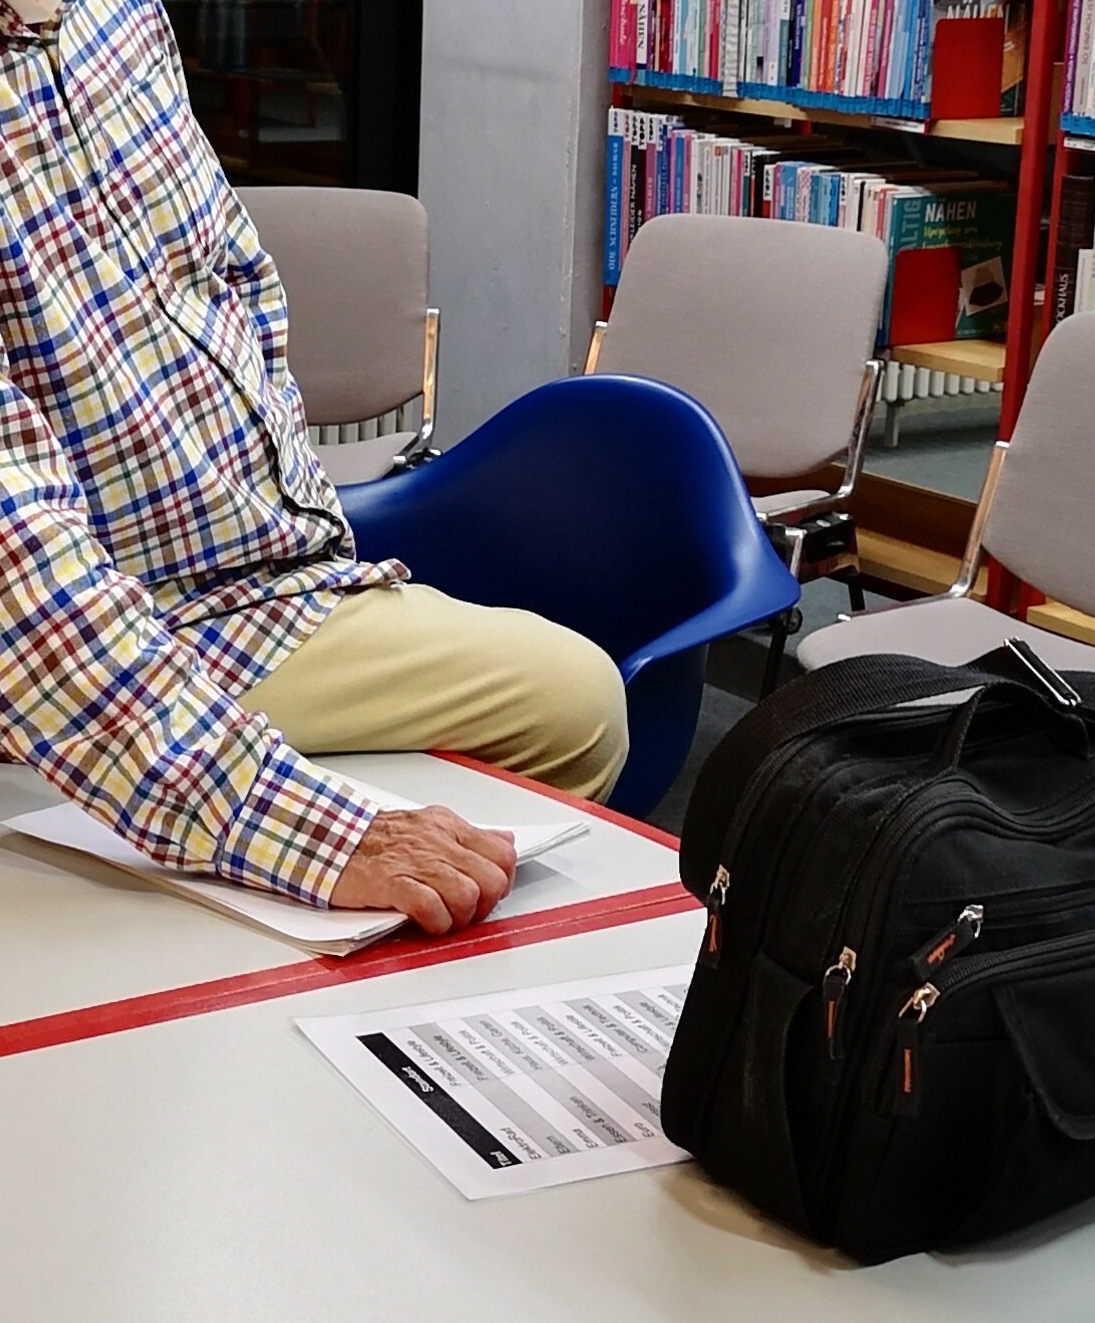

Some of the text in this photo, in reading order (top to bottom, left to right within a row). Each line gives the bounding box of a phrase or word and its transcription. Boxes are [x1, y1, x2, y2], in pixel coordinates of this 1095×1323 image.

[637, 4, 647, 49] NÄHEN
[925, 199, 977, 223] NÄHEN
[901, 199, 921, 249] ALTIG
[1056, 274, 1068, 322] OCKHAUS
[401, 1066, 433, 1092] Standort
[572, 1128, 598, 1148] Emma
[601, 1124, 627, 1143] Essen
[634, 1122, 654, 1137] Euro
